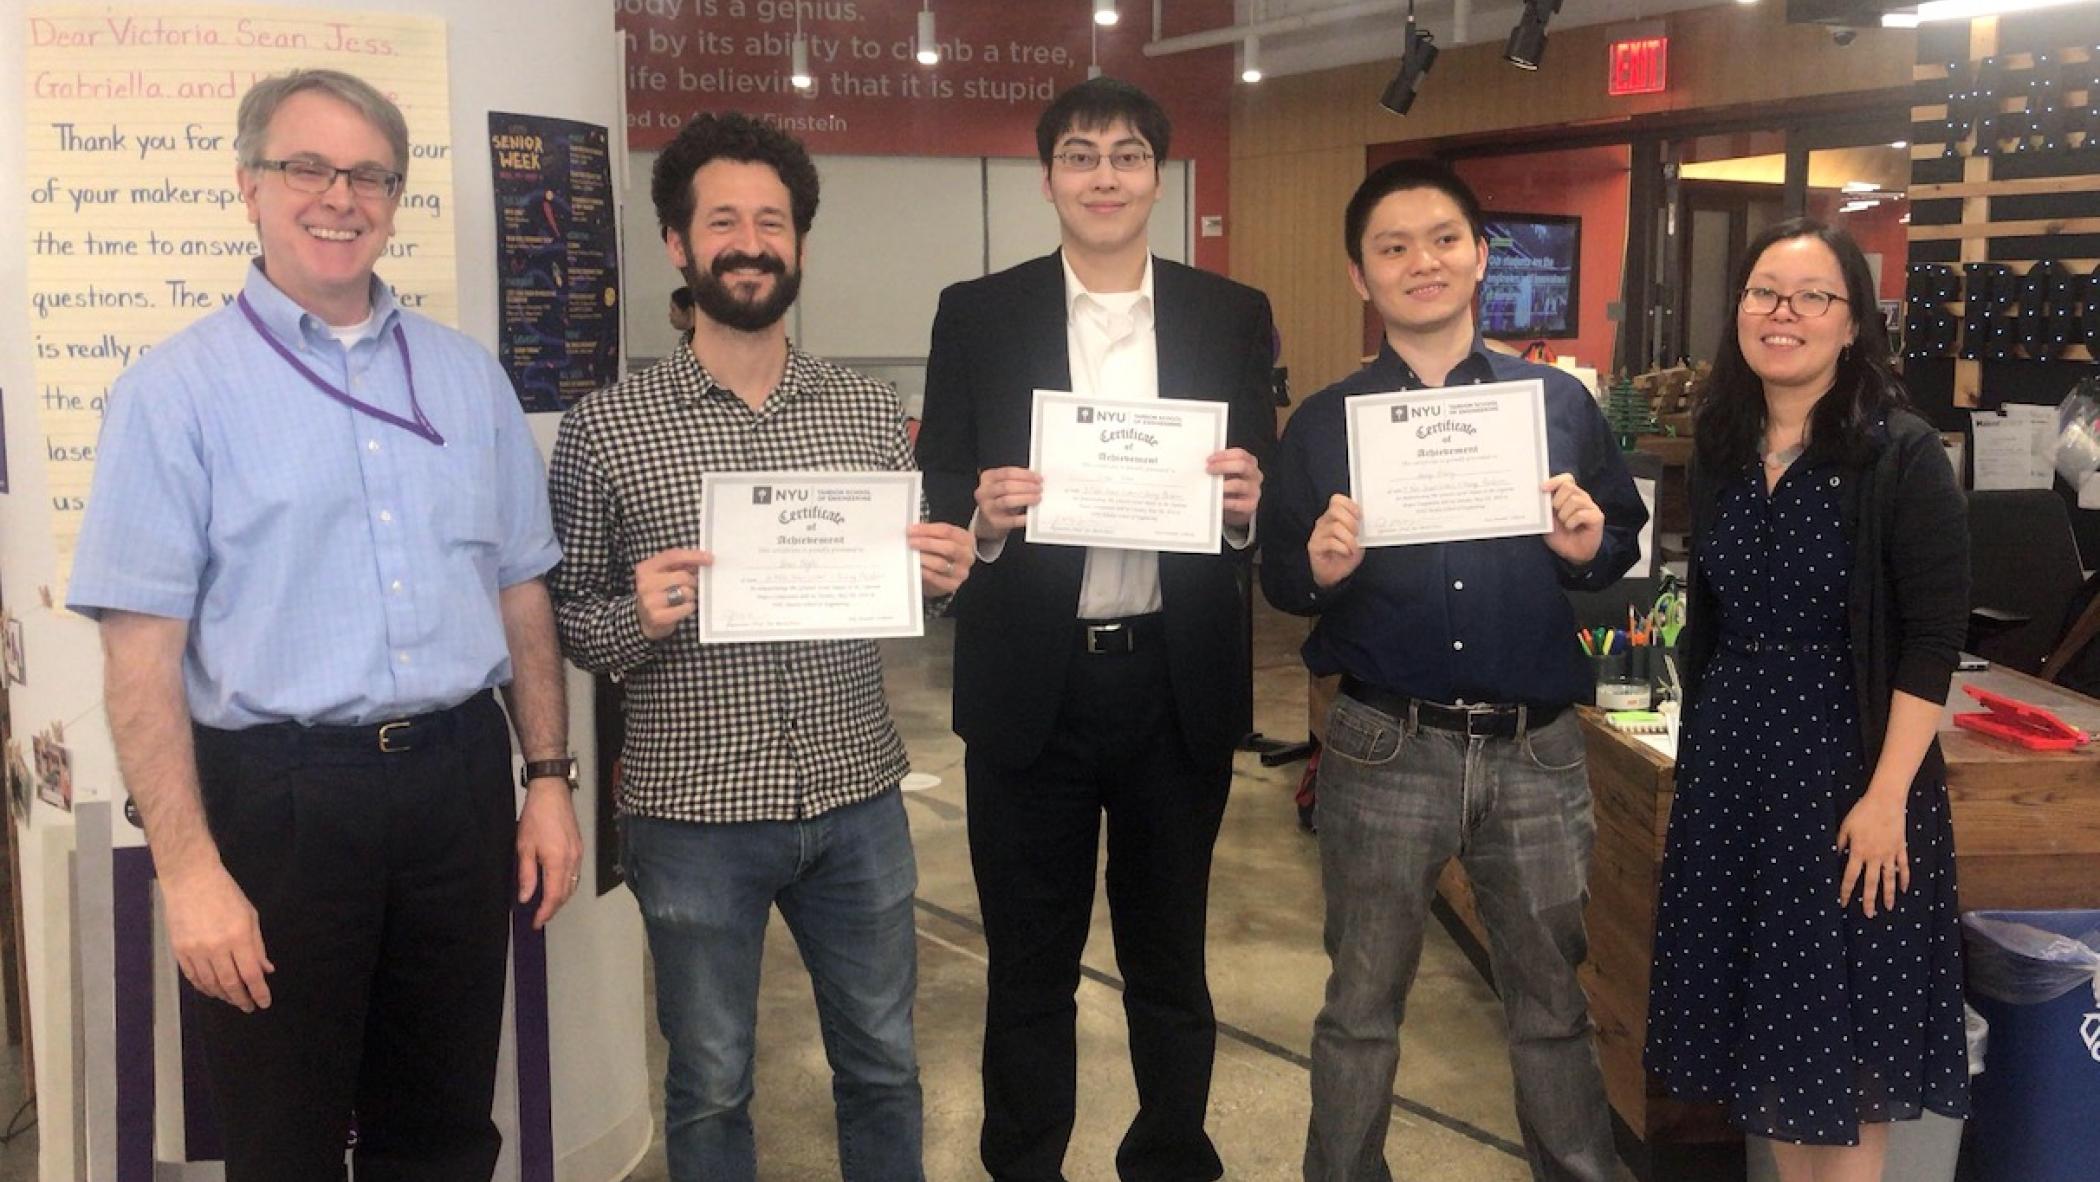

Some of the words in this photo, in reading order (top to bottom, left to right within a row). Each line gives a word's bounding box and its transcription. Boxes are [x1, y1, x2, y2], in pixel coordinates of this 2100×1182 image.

[696, 0, 717, 16] is
[729, 0, 745, 17] a
[29, 17, 100, 47] Dear
[107, 15, 218, 46] Victoria
[236, 18, 306, 48] Sean
[649, 28, 688, 58] by
[699, 29, 734, 55] its
[745, 31, 841, 62] abity
[851, 36, 881, 59] to
[891, 35, 973, 62] clmb
[984, 46, 999, 62] a
[1009, 40, 1075, 68] tree,
[1614, 40, 1661, 90] EXIT
[177, 71, 237, 99] and
[629, 65, 667, 91] ife
[831, 71, 890, 97] that
[902, 73, 920, 97] it
[931, 74, 953, 98] is
[658, 112, 681, 128] to
[51, 122, 127, 151] Thank
[136, 135, 176, 159] you
[185, 122, 224, 151] for
[491, 134, 544, 153] SENIOR
[498, 150, 541, 170] WEEK
[31, 177, 60, 203] of
[68, 187, 120, 213] your
[399, 191, 441, 218] ing
[33, 231, 75, 256] the
[84, 231, 138, 256] time
[147, 230, 174, 256] to
[180, 239, 259, 256] answe
[33, 284, 156, 319] questions.
[165, 280, 211, 308] The
[36, 335, 59, 358] is
[66, 334, 131, 368] really
[42, 384, 83, 410] the
[1096, 411, 1126, 423] NYU
[1411, 405, 1441, 417] NYU
[1100, 428, 1158, 447] Certificate
[1416, 419, 1477, 439] Certificate
[46, 435, 97, 461] lase
[1417, 446, 1478, 457] Achievement
[1098, 453, 1158, 464] Achievement
[53, 496, 84, 511] us
[775, 489, 808, 501] NYU
[778, 506, 845, 525] Certificate
[777, 535, 845, 546] Achievement
